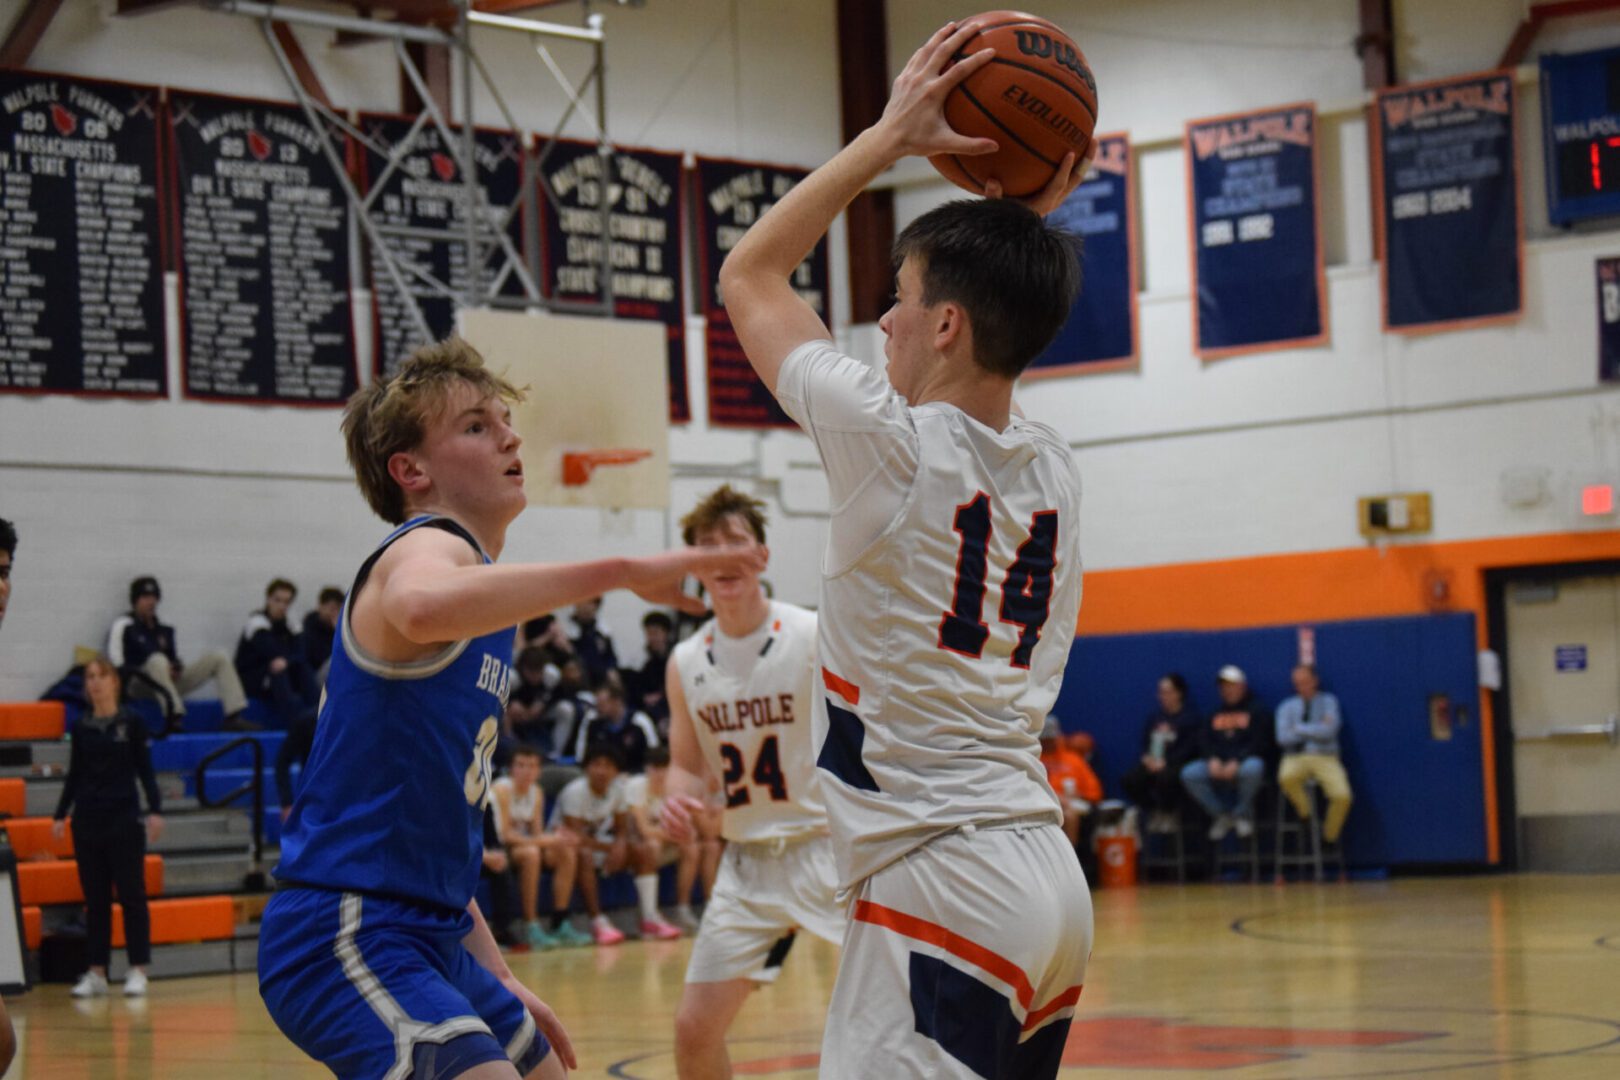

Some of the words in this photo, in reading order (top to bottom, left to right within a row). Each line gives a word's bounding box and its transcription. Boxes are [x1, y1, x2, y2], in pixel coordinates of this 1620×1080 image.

[3, 82, 59, 114] WALPOLE
[1383, 80, 1509, 130] WALPOLE
[200, 112, 255, 144] WALPOLE
[1192, 112, 1313, 161] WALPOLE
[1554, 117, 1620, 142] WALPOL
[14, 133, 117, 162] MASSACHUSETTS
[30, 155, 67, 177] STATE
[75, 161, 142, 183] CHAMPIONS
[551, 154, 606, 196] WALPOL
[937, 489, 1058, 670] 14
[720, 733, 790, 810] 24
